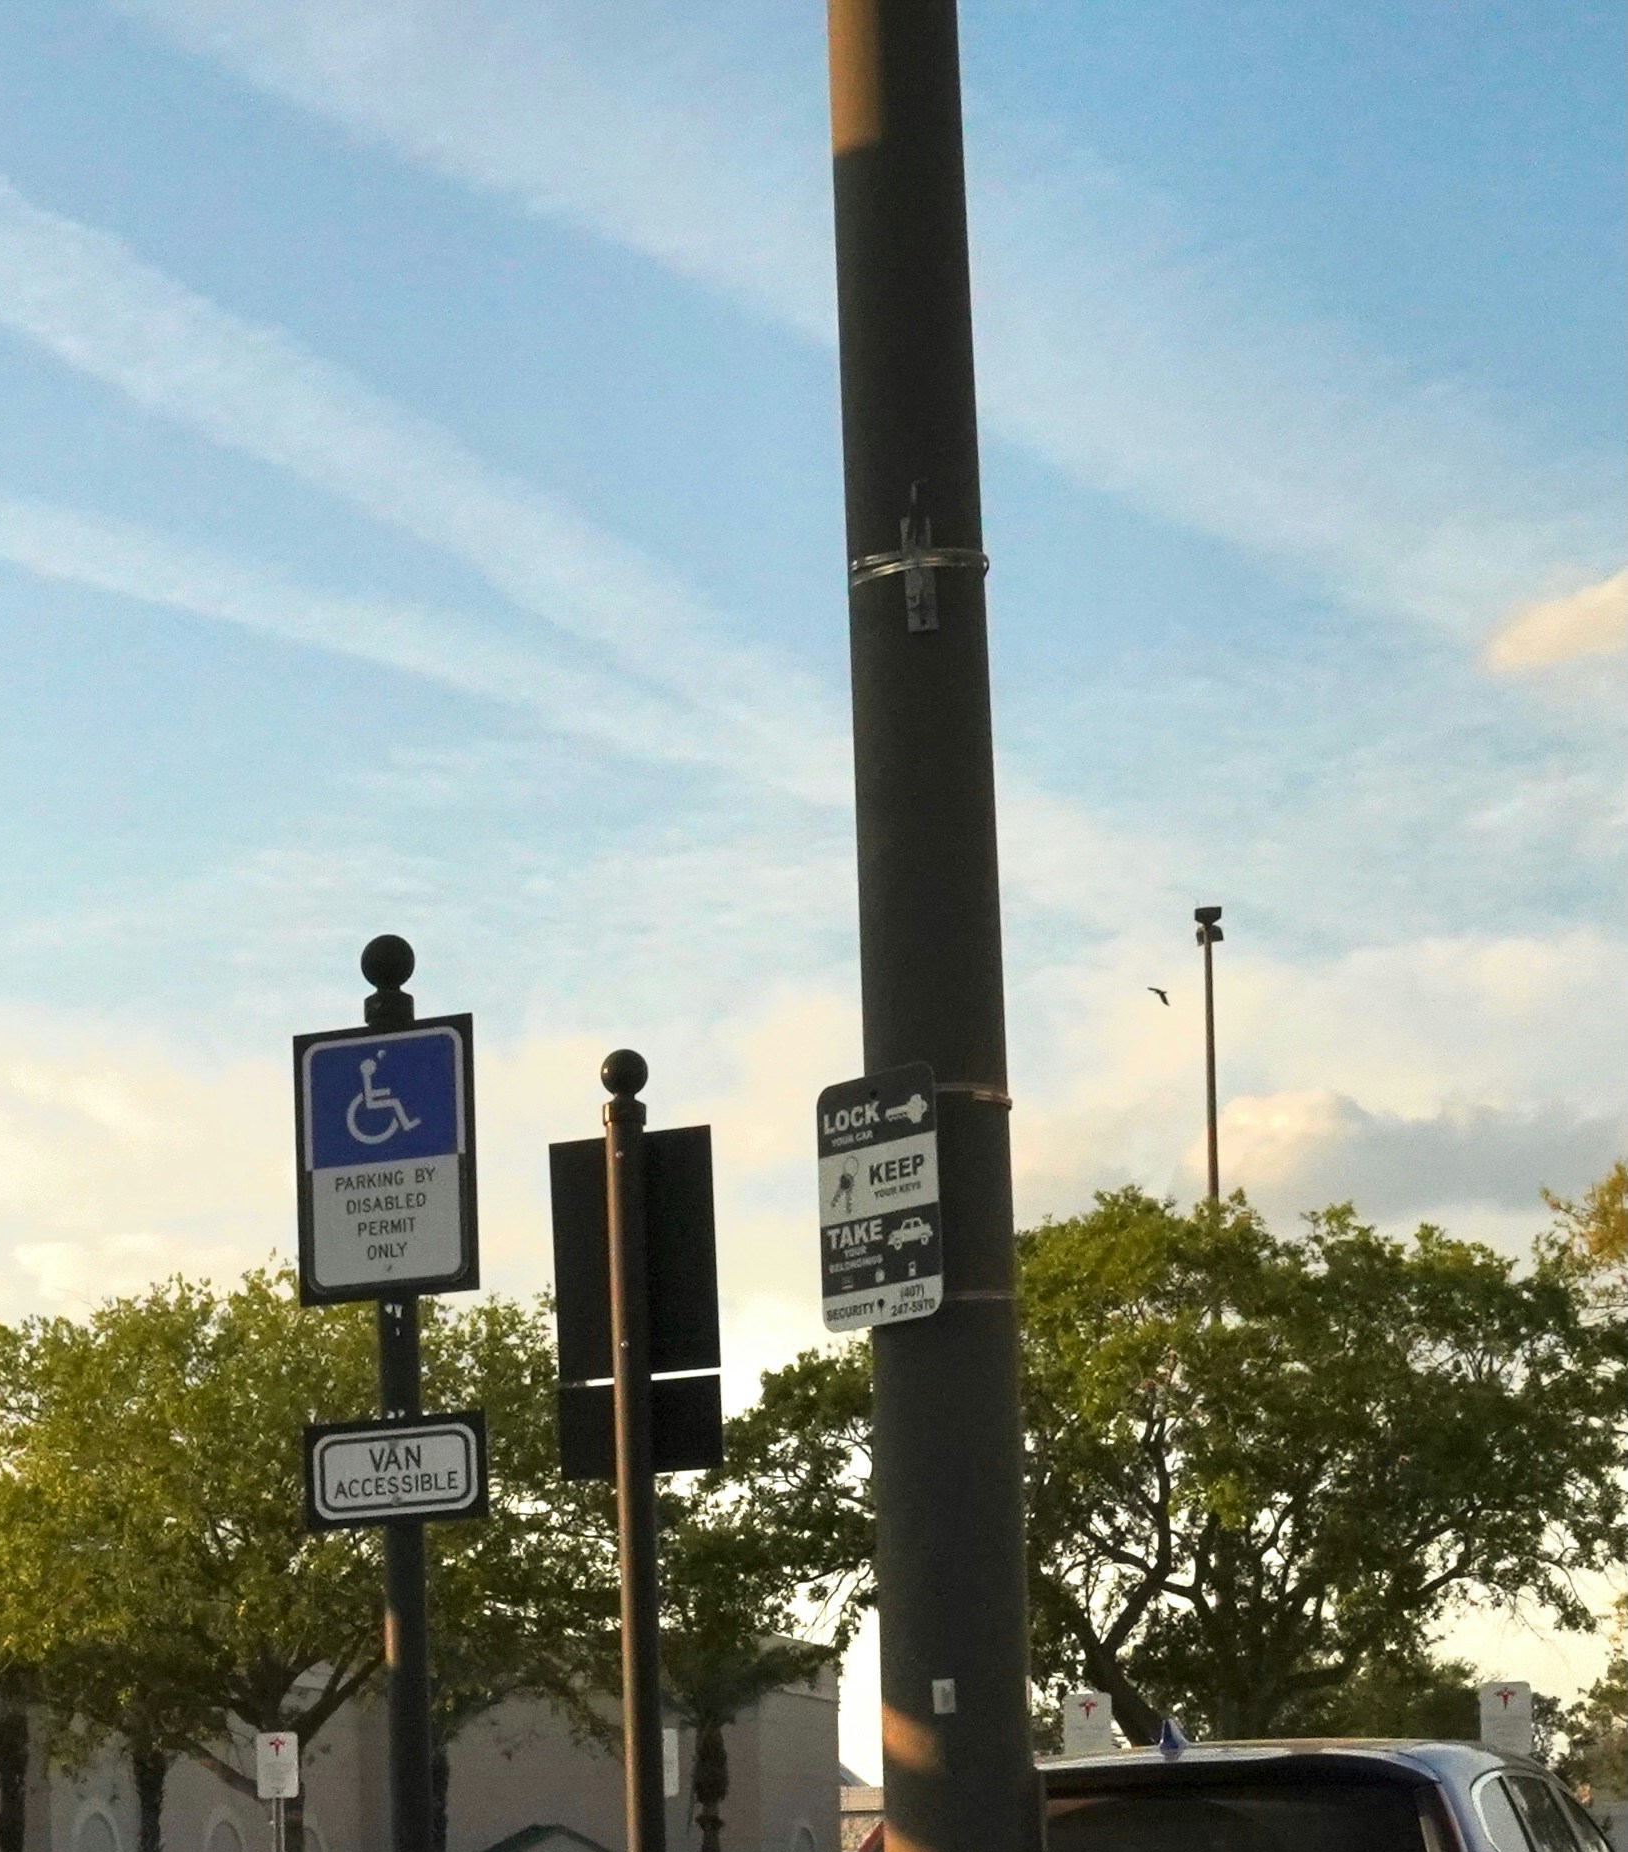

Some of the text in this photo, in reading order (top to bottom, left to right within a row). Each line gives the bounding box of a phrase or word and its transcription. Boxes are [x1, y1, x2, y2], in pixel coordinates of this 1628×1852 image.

[824, 1101, 881, 1135] LOCK
[335, 1167, 437, 1192] PARKING BY
[869, 1154, 924, 1185] KEEP
[874, 1181, 922, 1199] YOUR KEYS
[347, 1192, 427, 1215] DISABLED
[358, 1217, 417, 1238] PERMIT
[826, 1219, 884, 1250] TAKE
[367, 1241, 408, 1261] ONLY
[900, 1282, 925, 1300] (407)
[826, 1301, 875, 1321] SECURITY
[369, 1444, 422, 1473] VAN
[334, 1470, 458, 1500] ACCESSIBLE
